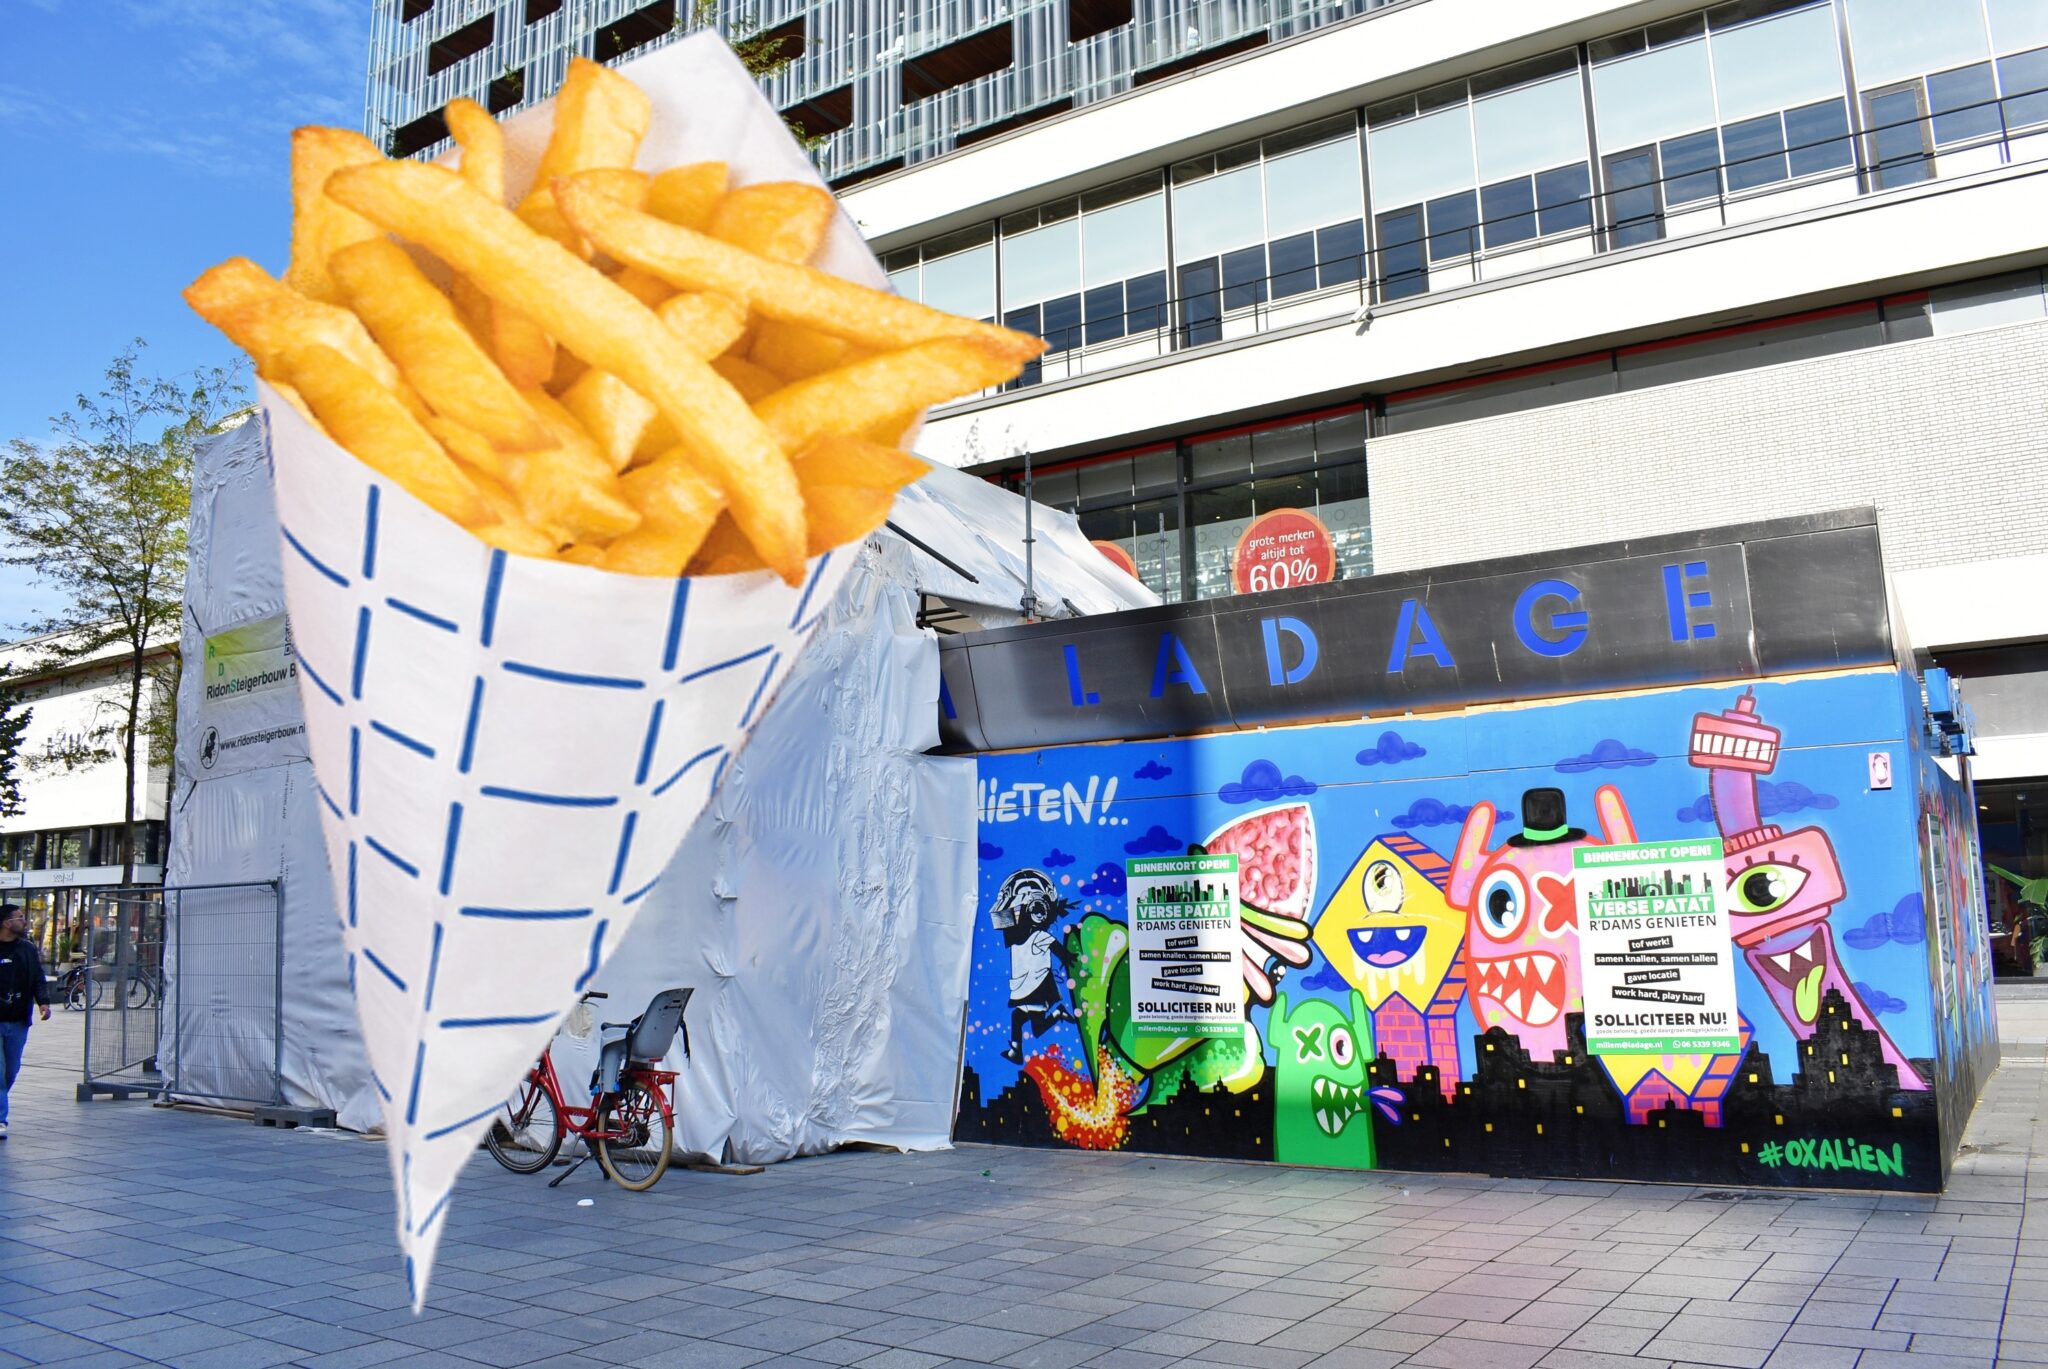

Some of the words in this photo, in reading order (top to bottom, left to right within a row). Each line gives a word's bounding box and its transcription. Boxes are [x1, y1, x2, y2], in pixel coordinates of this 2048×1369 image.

[1249, 536, 1275, 550] grote
[1278, 530, 1315, 543] merken
[1261, 546, 1286, 561] altijd
[1289, 545, 1305, 556] tot
[1249, 558, 1318, 593] 60%
[1063, 561, 1716, 707] LADAGE
[208, 646, 215, 659] R
[218, 663, 225, 677] D
[206, 667, 288, 700] RidonSteigerbouw
[220, 723, 306, 750] www.ridonsteigerbouw.nl
[1583, 848, 1667, 863] BINNENKORT
[1670, 846, 1712, 858] OPEN!
[1134, 861, 1197, 873] BINNENKORT
[1198, 859, 1230, 870] OPEN!
[1138, 905, 1182, 919] VERSE
[1184, 903, 1228, 918] PATAT
[1591, 901, 1649, 917] VERSE
[1653, 898, 1711, 914] PATAT
[1137, 920, 1176, 931] R'DAMS
[1178, 919, 1231, 930] GENIETEN
[1590, 919, 1641, 931] R'DAMS
[1646, 916, 1717, 929] GENIETEN
[1167, 939, 1177, 947] tof
[1177, 937, 1196, 946] werk!
[1632, 940, 1644, 949] tof
[1645, 938, 1670, 948] werk!
[1162, 951, 1188, 960] knallen,
[1211, 952, 1230, 961] lallen
[1596, 955, 1623, 963] samen
[1625, 954, 1659, 964] knallen,
[1661, 955, 1690, 963] samen
[1691, 954, 1716, 963] lallen
[1163, 967, 1178, 976] gave
[1179, 965, 1201, 974] locatie
[1627, 974, 1647, 984] gave
[1649, 971, 1678, 981] locatie
[1153, 979, 1170, 988] work
[1170, 981, 1188, 991] hard,
[1188, 983, 1203, 994] play
[1203, 985, 1219, 994] hard
[1614, 989, 1637, 998] work
[1638, 990, 1660, 1000] hard,
[1662, 991, 1681, 1002] play
[1682, 993, 1703, 1002] hard
[1137, 1002, 1212, 1013] SOLLICITEER
[1215, 1002, 1236, 1013] NU!
[1594, 1013, 1695, 1027] SOLLICITEER
[1699, 1012, 1727, 1025] NU!
